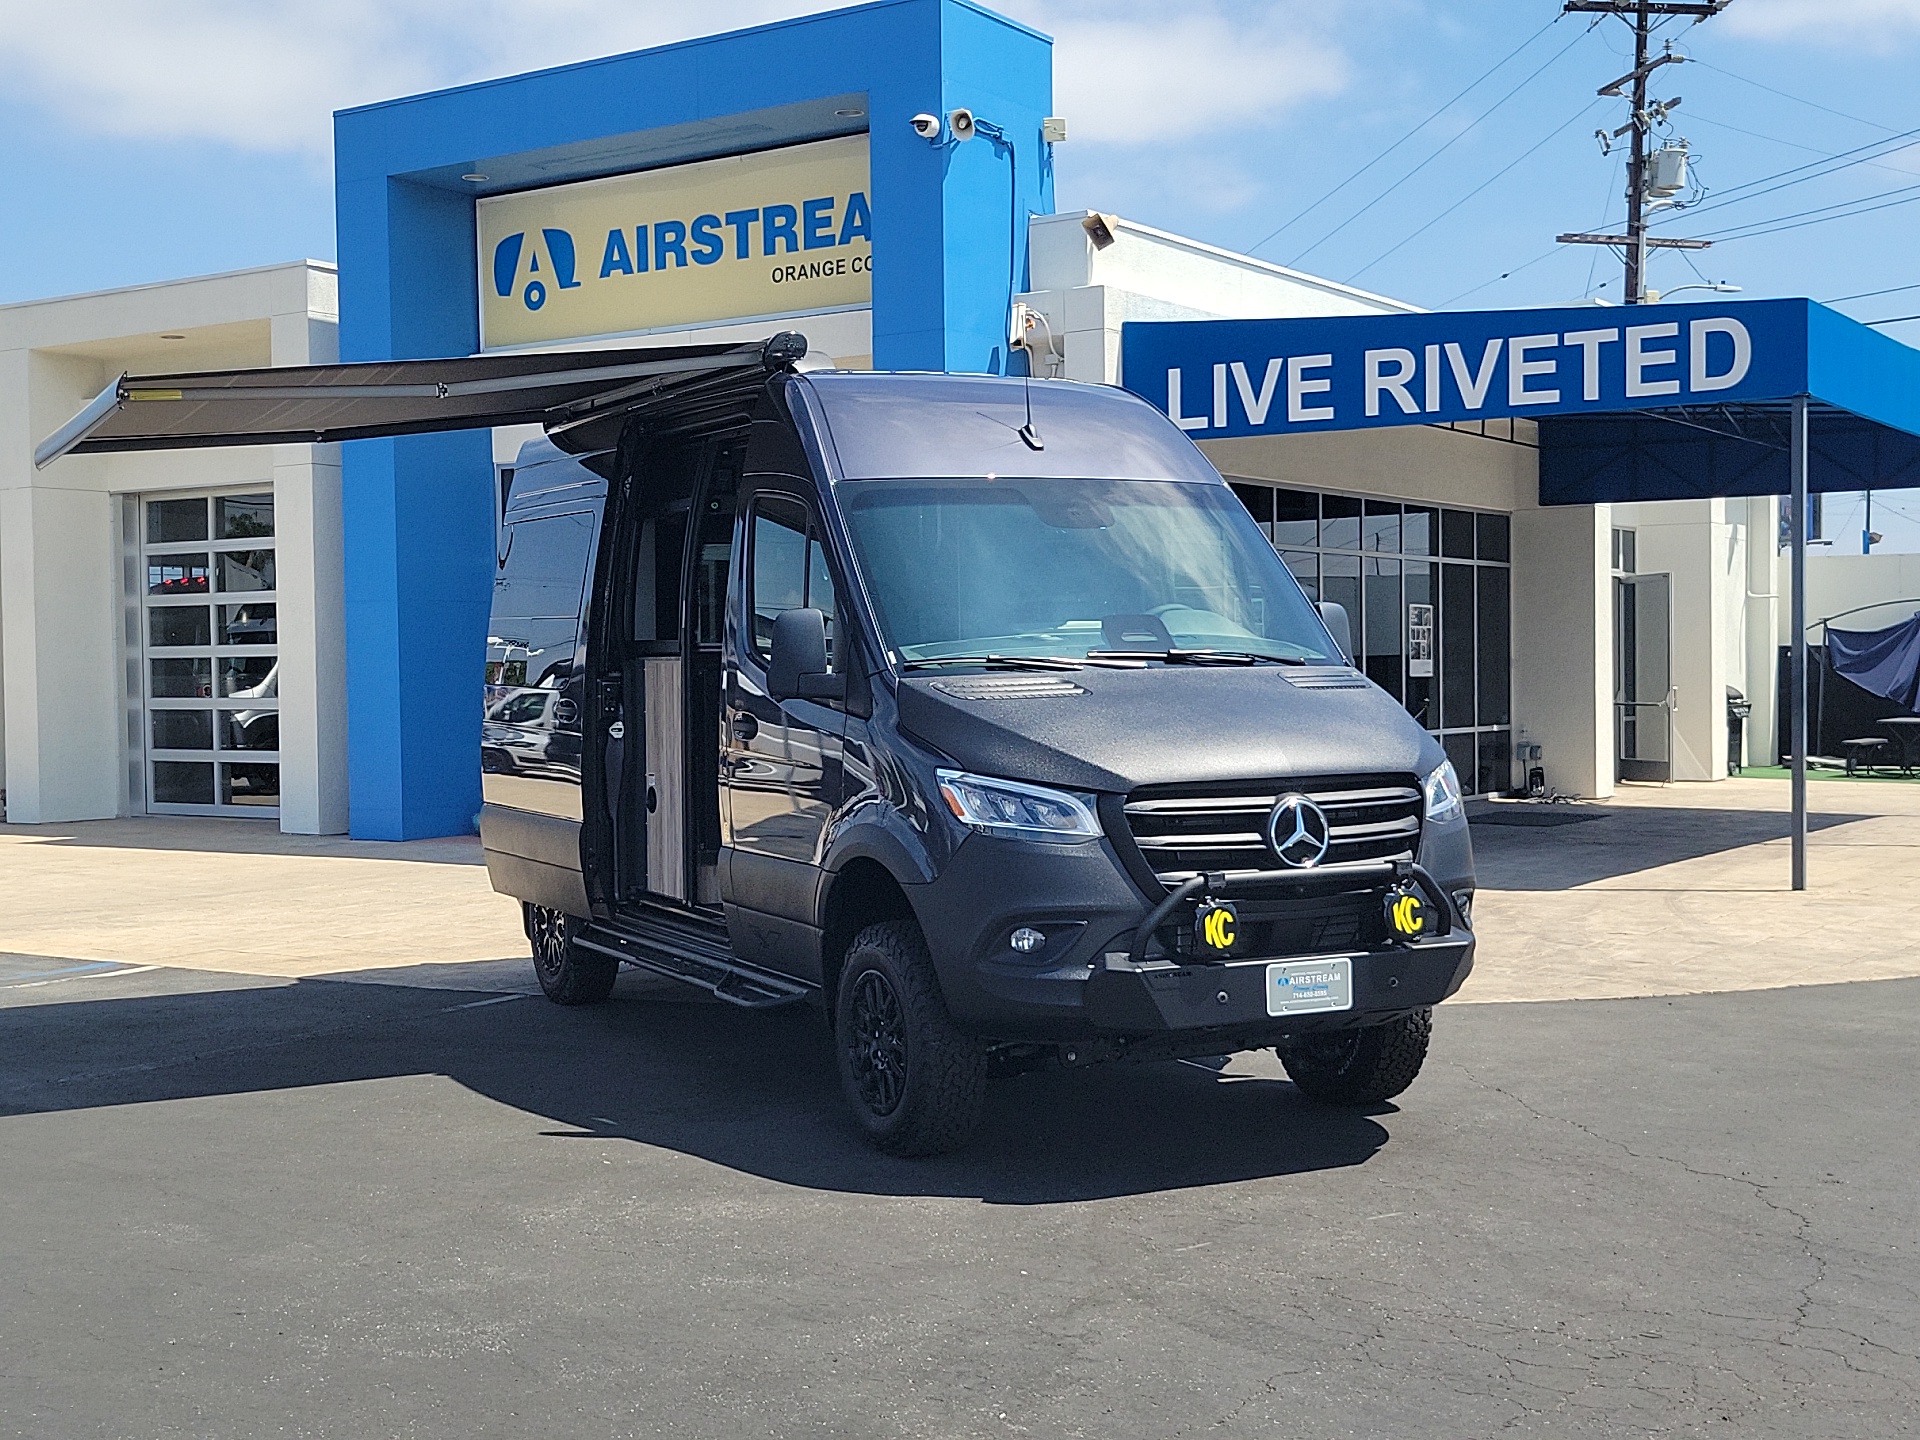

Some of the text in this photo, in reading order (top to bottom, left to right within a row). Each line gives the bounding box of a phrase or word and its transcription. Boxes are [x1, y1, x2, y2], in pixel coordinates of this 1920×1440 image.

[599, 191, 872, 279] AIRSTREA
[771, 258, 846, 284] ORANGE
[1167, 316, 1753, 431] LIVE RIVETED
[1204, 908, 1236, 949] KC
[1392, 895, 1423, 935] KC
[1289, 972, 1341, 985] AIRSTREAM
